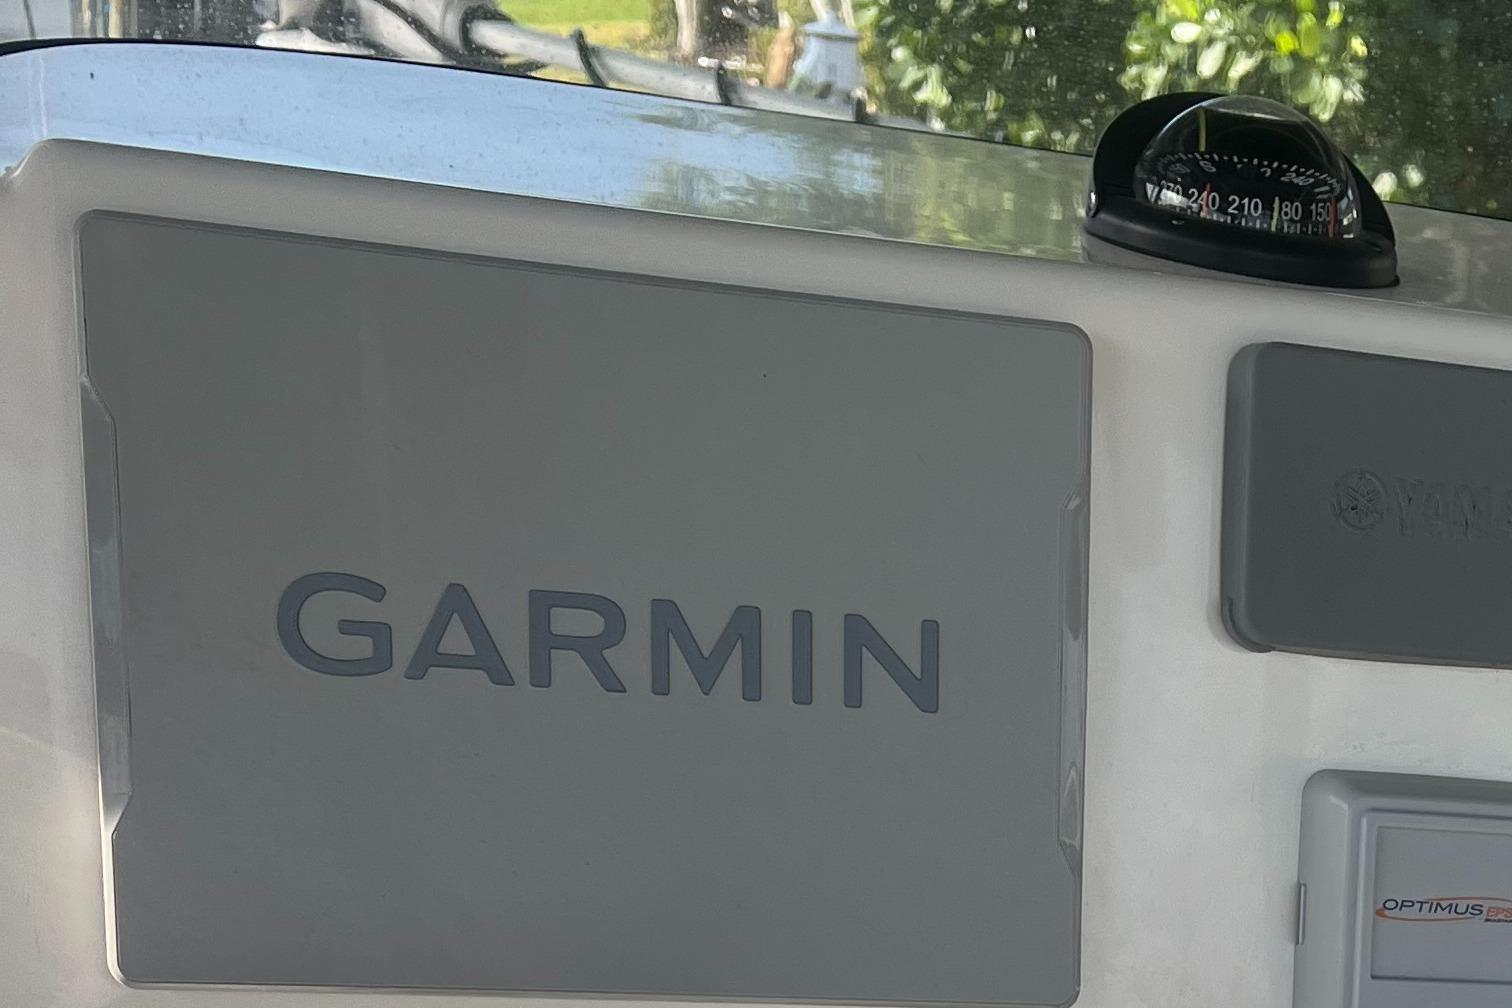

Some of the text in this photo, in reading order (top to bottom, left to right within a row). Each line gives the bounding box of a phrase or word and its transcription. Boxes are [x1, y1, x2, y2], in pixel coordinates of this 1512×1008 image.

[1227, 195, 1263, 217] 210
[276, 571, 940, 714] GARMIN
[1382, 898, 1484, 916] OPTIMUS
